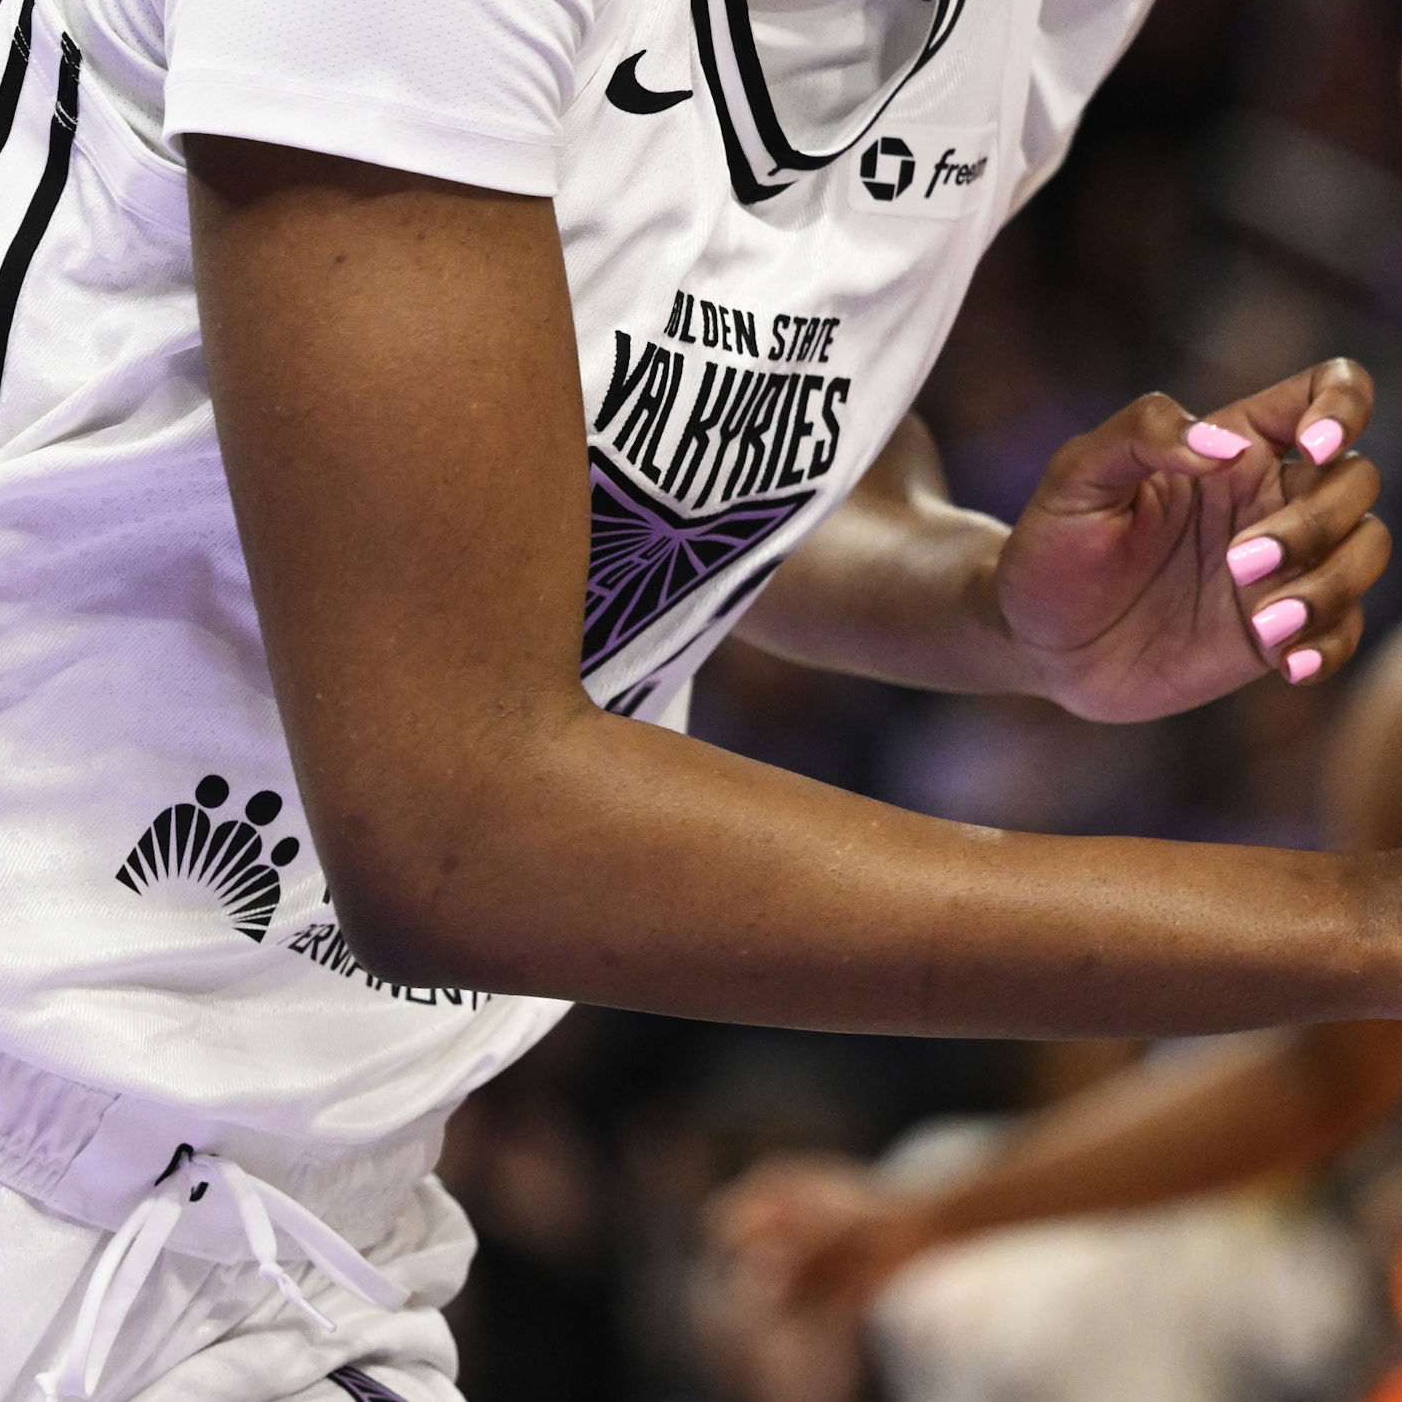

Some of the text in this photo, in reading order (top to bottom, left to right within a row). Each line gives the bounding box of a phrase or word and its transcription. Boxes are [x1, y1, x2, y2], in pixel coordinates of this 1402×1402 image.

[663, 289, 841, 363] OLDEN STATE
[593, 330, 851, 511] VALKYRIES
